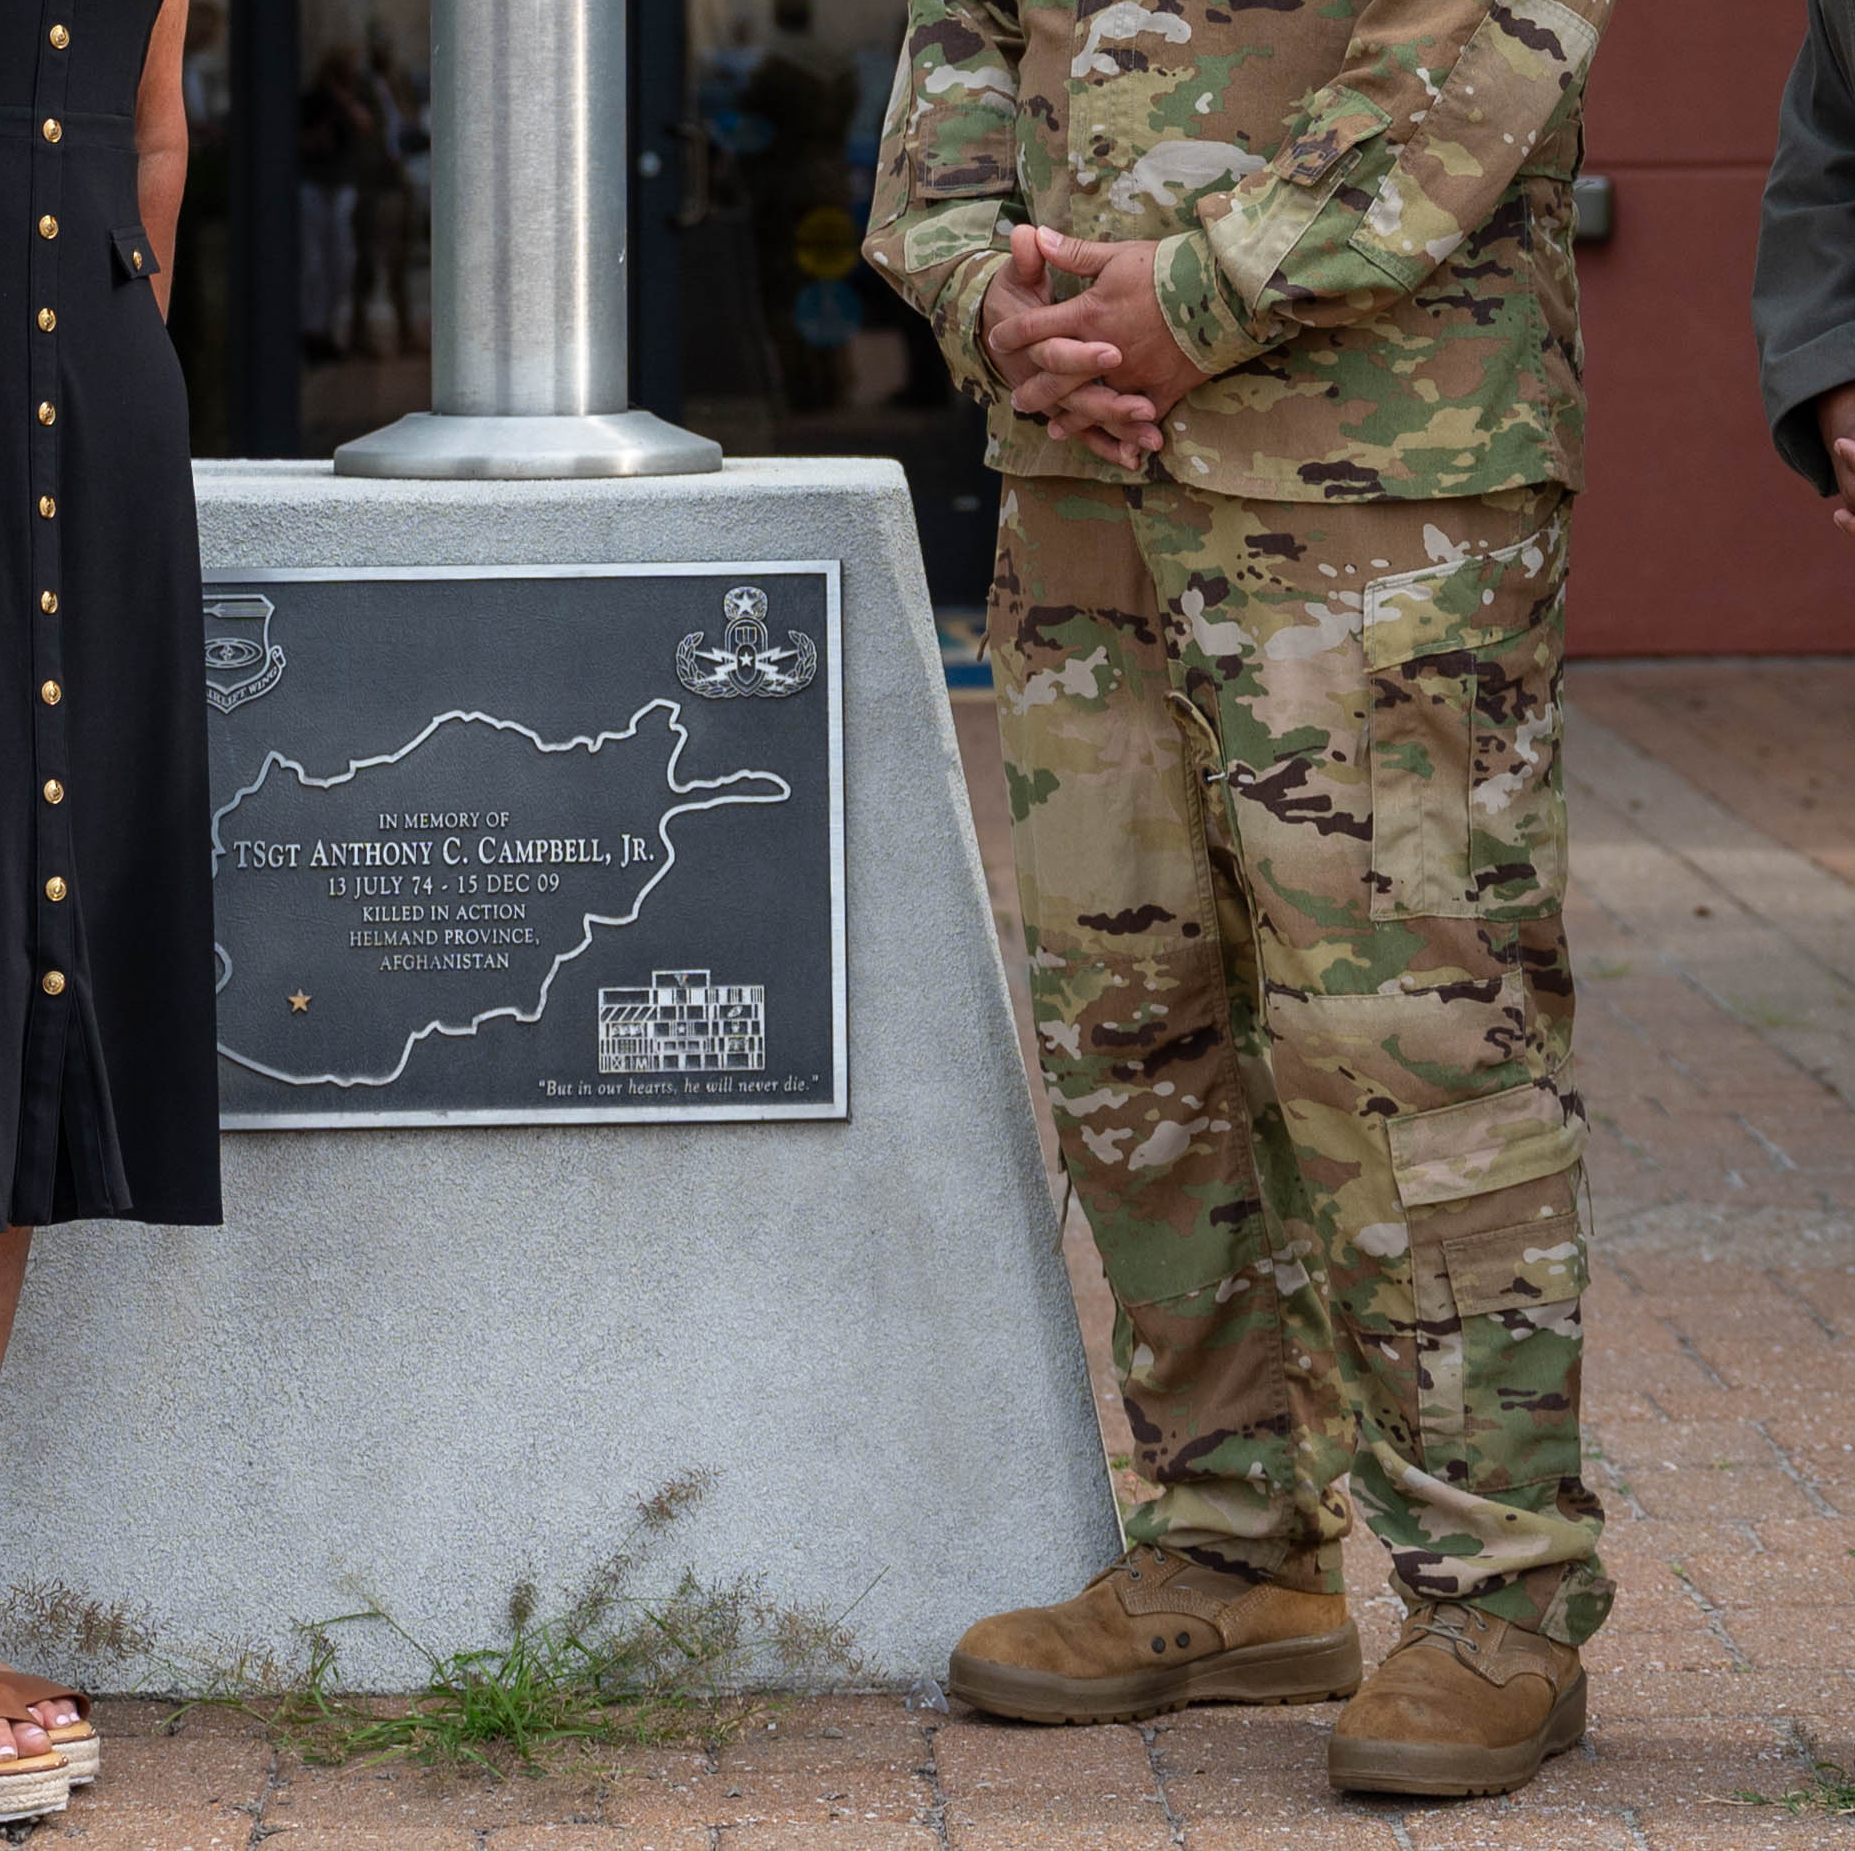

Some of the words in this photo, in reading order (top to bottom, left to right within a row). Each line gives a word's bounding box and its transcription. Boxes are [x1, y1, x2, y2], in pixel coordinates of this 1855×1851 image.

[248, 665, 277, 695] WING
[379, 813, 398, 829] IN
[404, 811, 480, 829] MEMORY
[485, 811, 510, 828] OF
[309, 839, 433, 867] ANTHONY
[442, 836, 469, 865] C.
[328, 877, 346, 896] 13
[353, 876, 403, 899] JULY
[412, 875, 433, 895] 74
[457, 875, 479, 893] 15
[486, 873, 530, 893] DEC
[537, 873, 560, 892] 09
[362, 906, 425, 922] KILLED
[430, 905, 449, 920] IN
[456, 904, 526, 920] ACTION
[349, 930, 438, 947] HELMAND
[444, 928, 540, 946] PROVINCE,
[379, 953, 510, 971] AFGHANISTAN
[578, 1079, 593, 1095] in
[597, 1082, 624, 1095] our
[628, 1077, 678, 1096] hearts,
[684, 1077, 701, 1094] he
[706, 1076, 734, 1093] will
[738, 1079, 779, 1092] never
